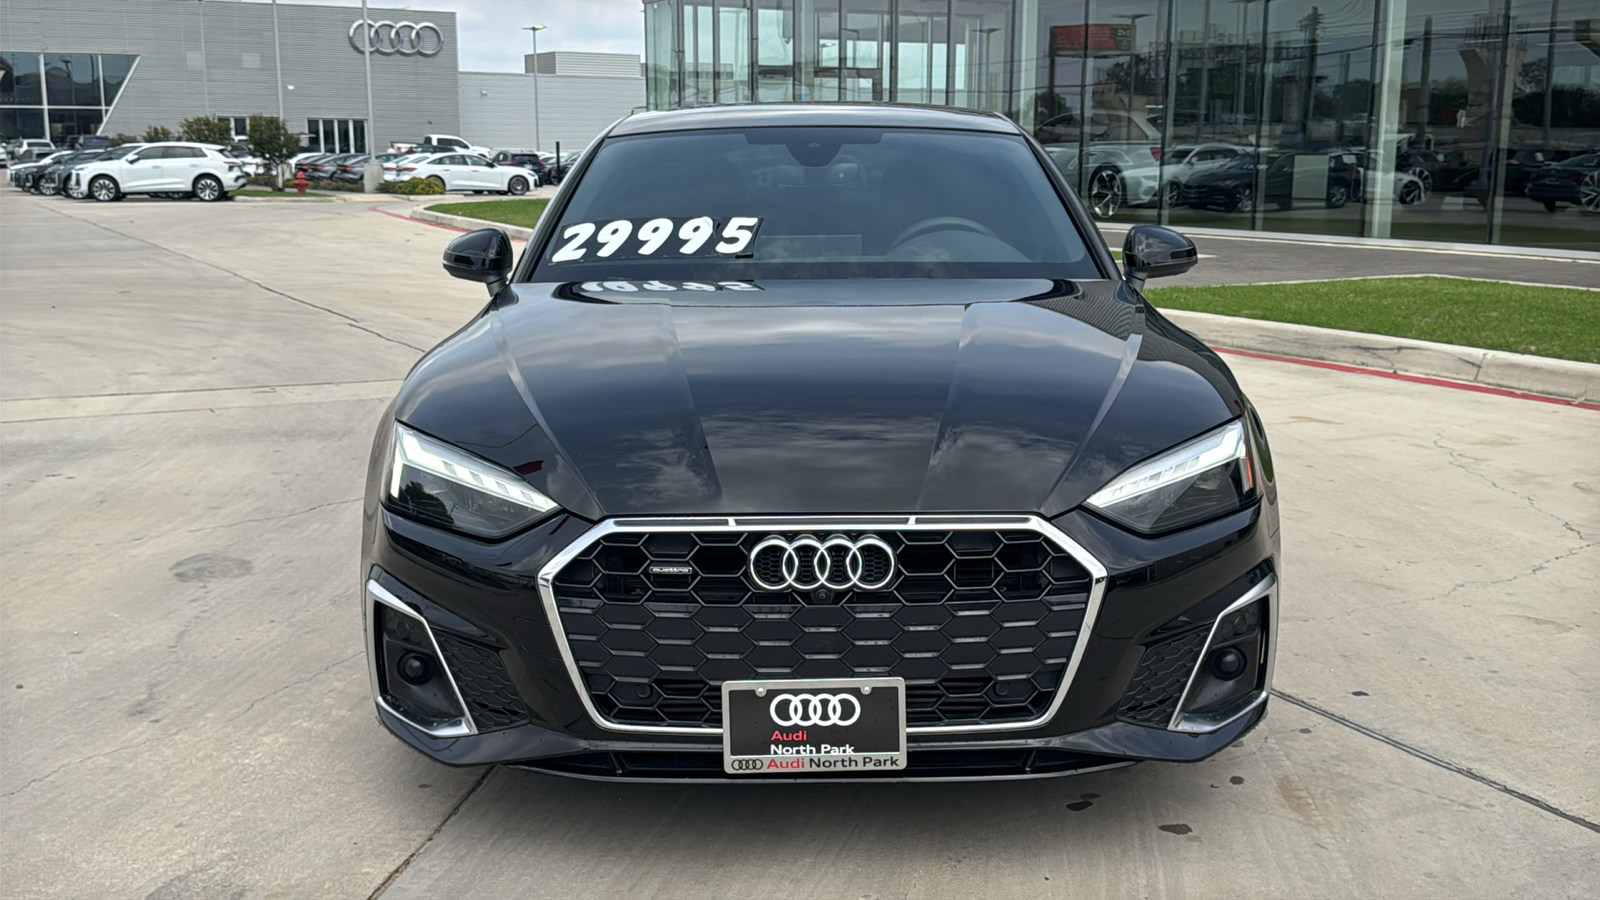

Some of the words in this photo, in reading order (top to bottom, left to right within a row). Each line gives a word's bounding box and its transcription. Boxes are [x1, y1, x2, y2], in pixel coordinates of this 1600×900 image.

[551, 216, 758, 263] 29995
[770, 730, 807, 741] Audi
[770, 744, 816, 755] North
[821, 744, 855, 755] Park
[766, 758, 805, 770] Audi
[809, 757, 858, 768] North
[862, 756, 899, 767] Park
